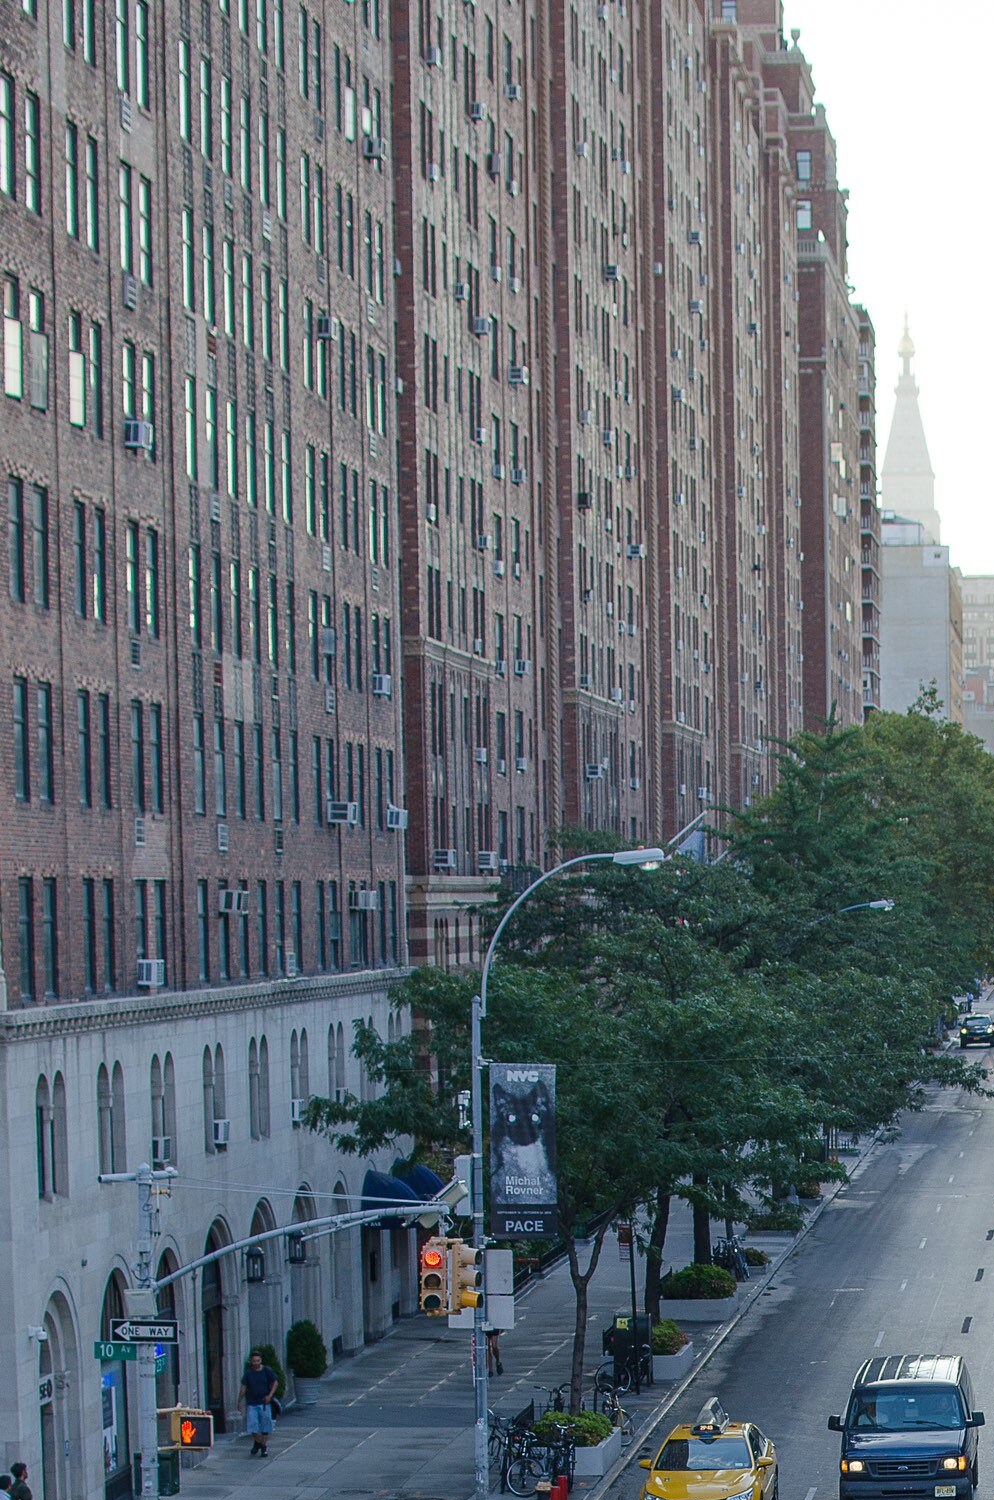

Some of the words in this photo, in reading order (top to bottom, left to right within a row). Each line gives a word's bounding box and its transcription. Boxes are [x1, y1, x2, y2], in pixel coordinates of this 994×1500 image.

[507, 1069, 539, 1082] NYC
[505, 1175, 541, 1186] Michal
[505, 1186, 544, 1195] Rovner
[505, 1220, 544, 1232] PACE
[121, 1327, 140, 1336] ONE
[149, 1327, 169, 1336] WAY
[100, 1344, 114, 1357] 10
